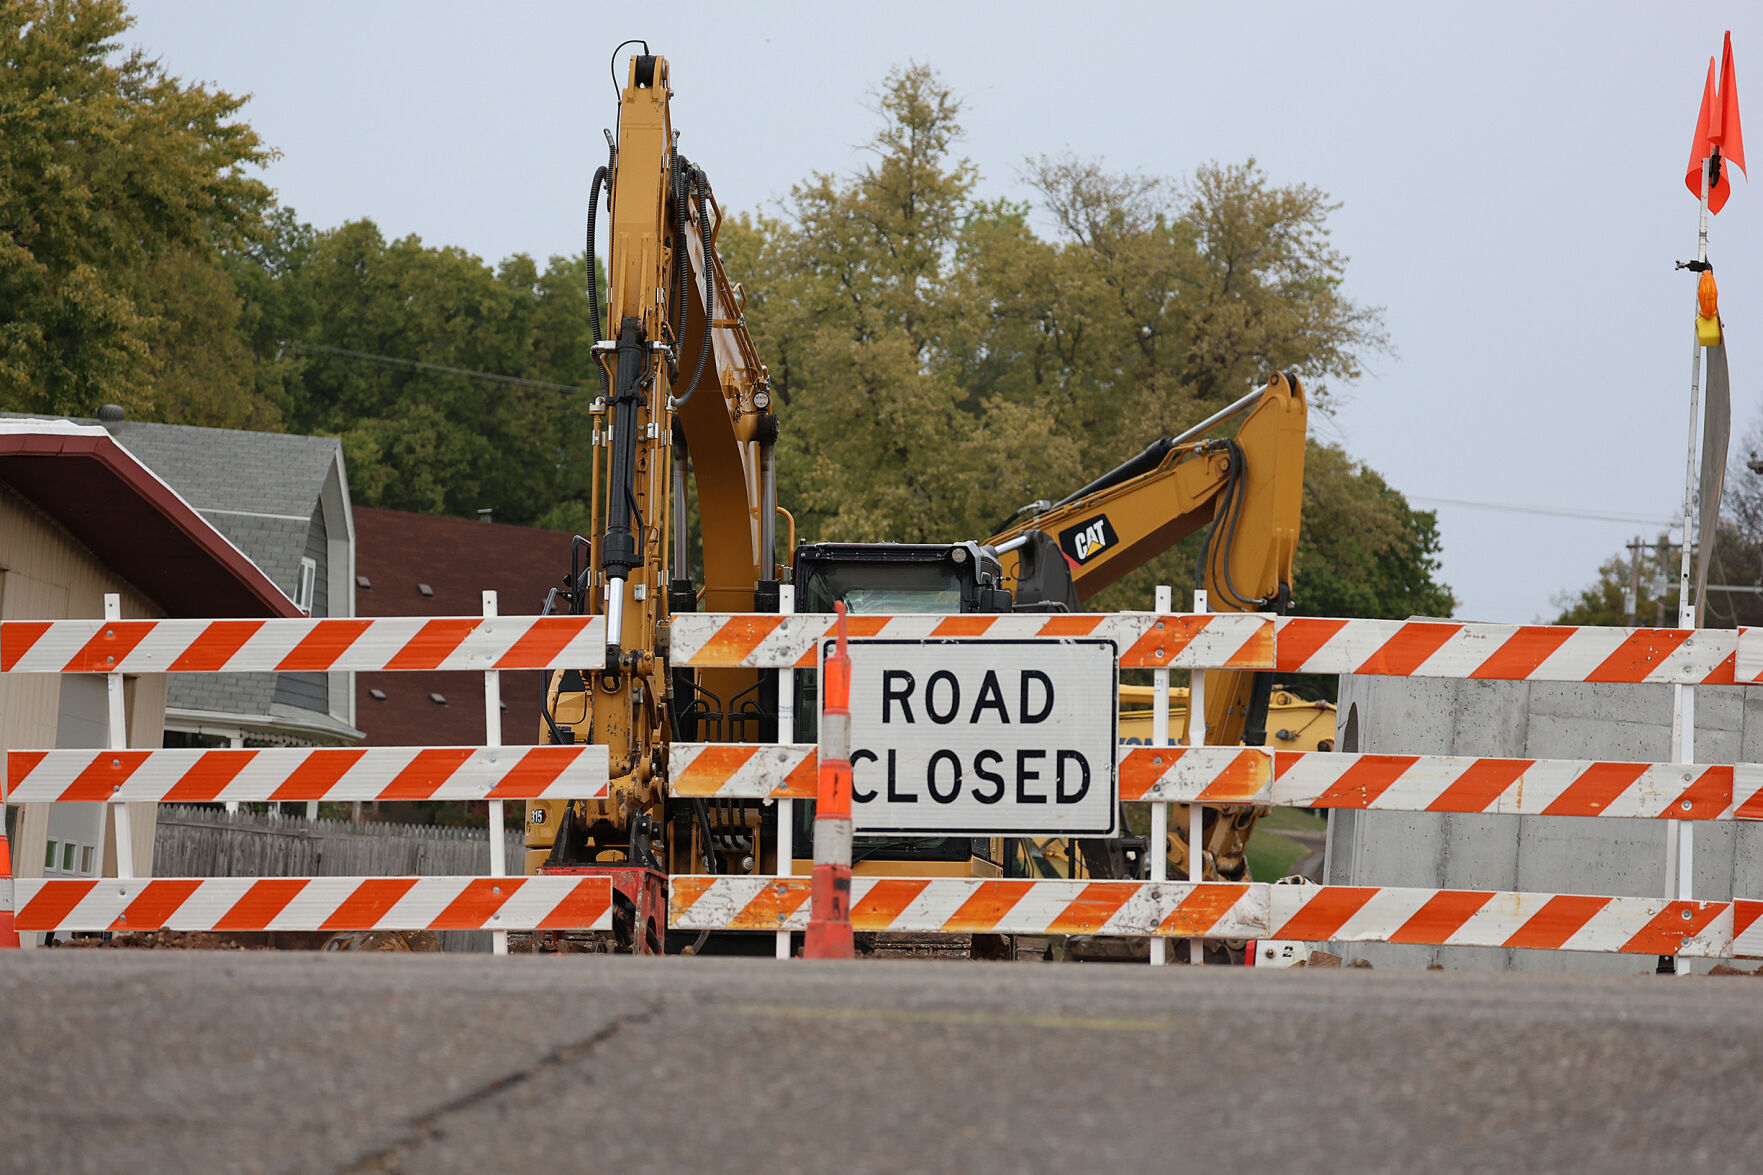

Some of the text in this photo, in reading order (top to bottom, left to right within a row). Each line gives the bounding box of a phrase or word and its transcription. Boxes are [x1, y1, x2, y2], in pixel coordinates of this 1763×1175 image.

[1074, 519, 1106, 560] CAT
[882, 669, 1055, 725] ROAD
[850, 749, 1091, 805] CLOSED
[531, 810, 543, 823] 315
